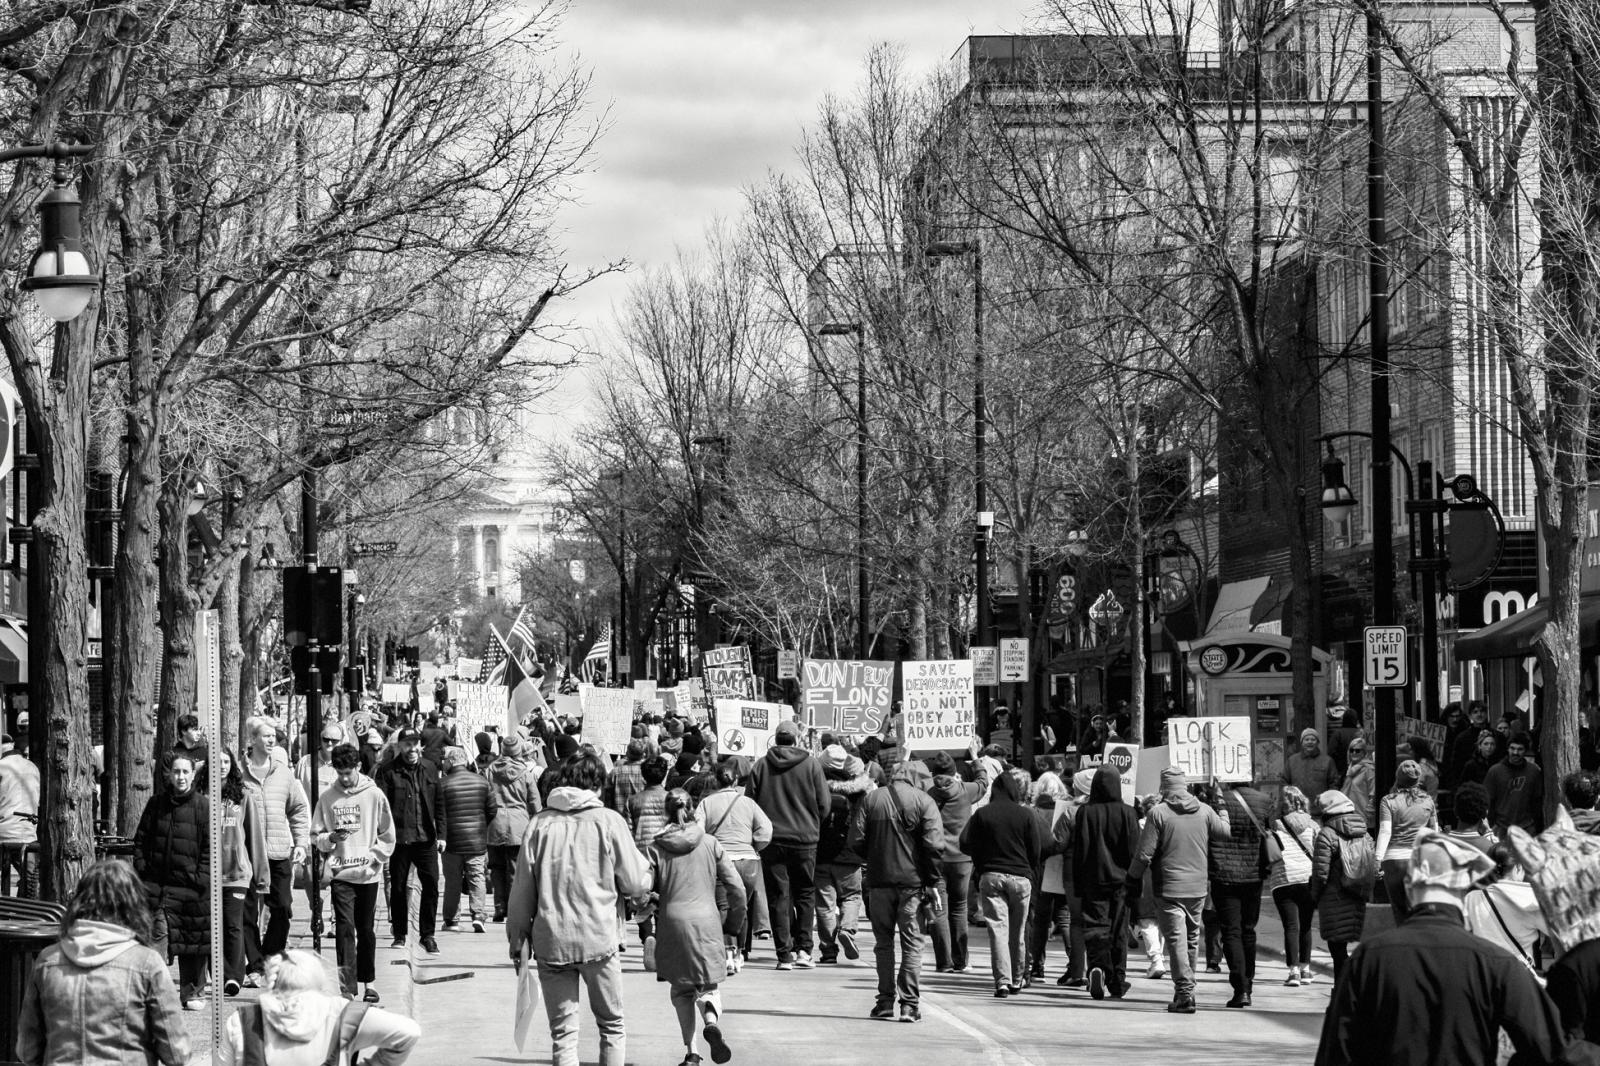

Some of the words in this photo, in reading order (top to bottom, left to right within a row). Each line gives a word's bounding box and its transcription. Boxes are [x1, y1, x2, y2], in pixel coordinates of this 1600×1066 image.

[1369, 632, 1402, 643] SPEED
[1010, 642, 1018, 650] NO
[1372, 643, 1399, 655] LIMIT
[919, 663, 956, 676] SAVE
[1372, 657, 1399, 680] 15
[906, 677, 971, 690] DEMOCRACY
[910, 697, 929, 710] DO
[939, 696, 967, 709] NOT
[743, 709, 767, 718] THIS
[807, 706, 882, 734] LIES
[907, 710, 943, 724] OBEY
[955, 710, 973, 723] IN
[752, 717, 767, 725] NOT
[908, 724, 975, 738] ADVANCE!
[1174, 720, 1231, 744] LOCK
[1414, 720, 1445, 742] NEVER
[1110, 755, 1131, 767] STOP
[1176, 745, 1217, 774] HIM
[1223, 744, 1249, 774] UP
